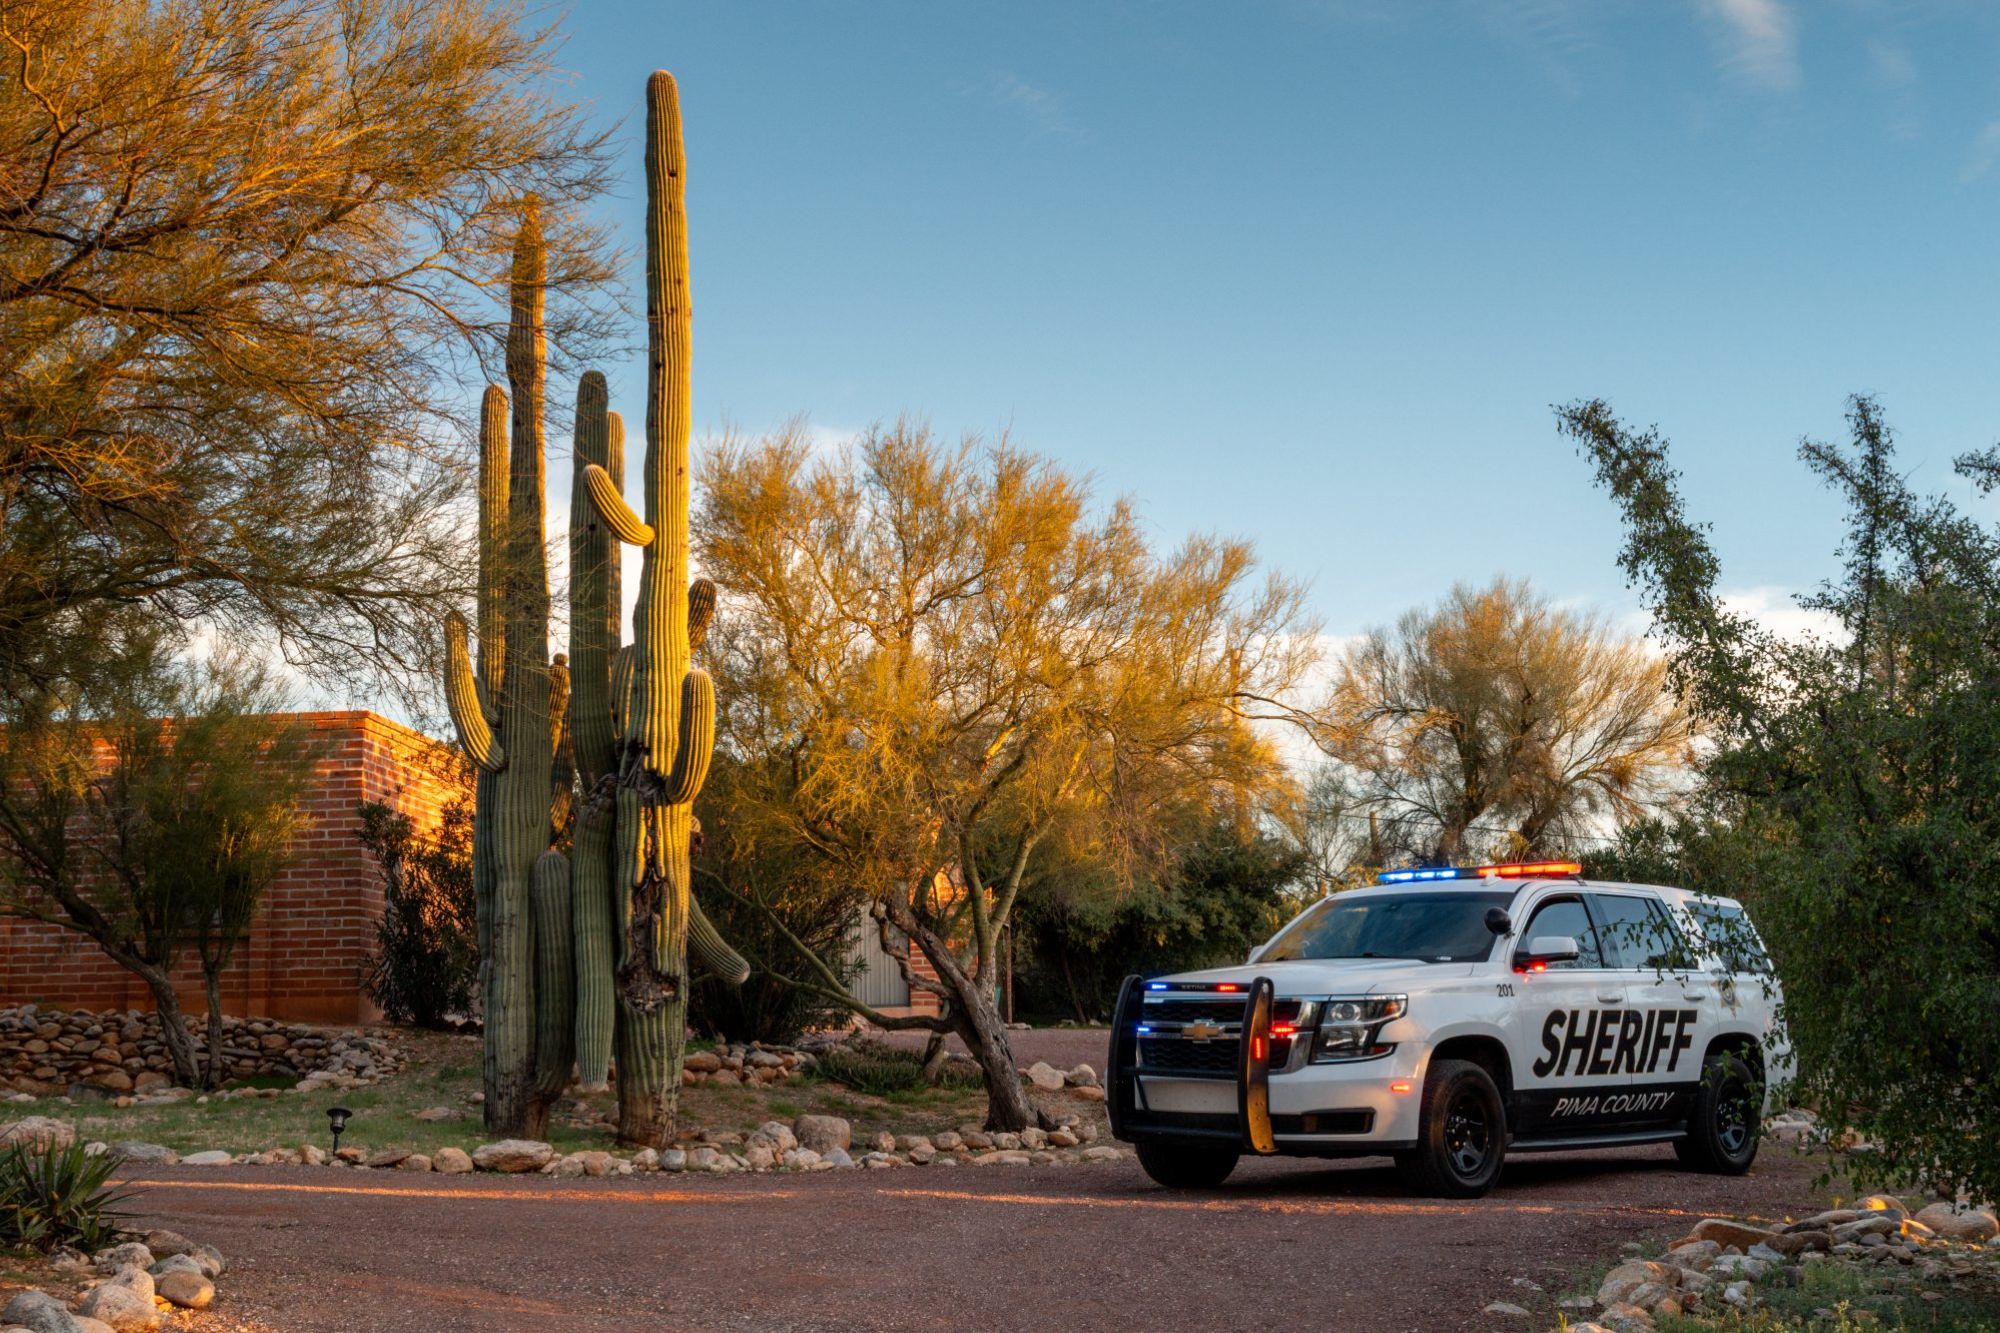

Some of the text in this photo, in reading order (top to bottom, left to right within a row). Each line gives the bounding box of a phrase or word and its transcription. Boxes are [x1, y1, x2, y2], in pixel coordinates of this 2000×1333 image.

[1496, 983, 1515, 997] 201
[1532, 1009, 1698, 1078] SHERIFF
[1550, 1091, 1675, 1117] PIMA COUNTY
